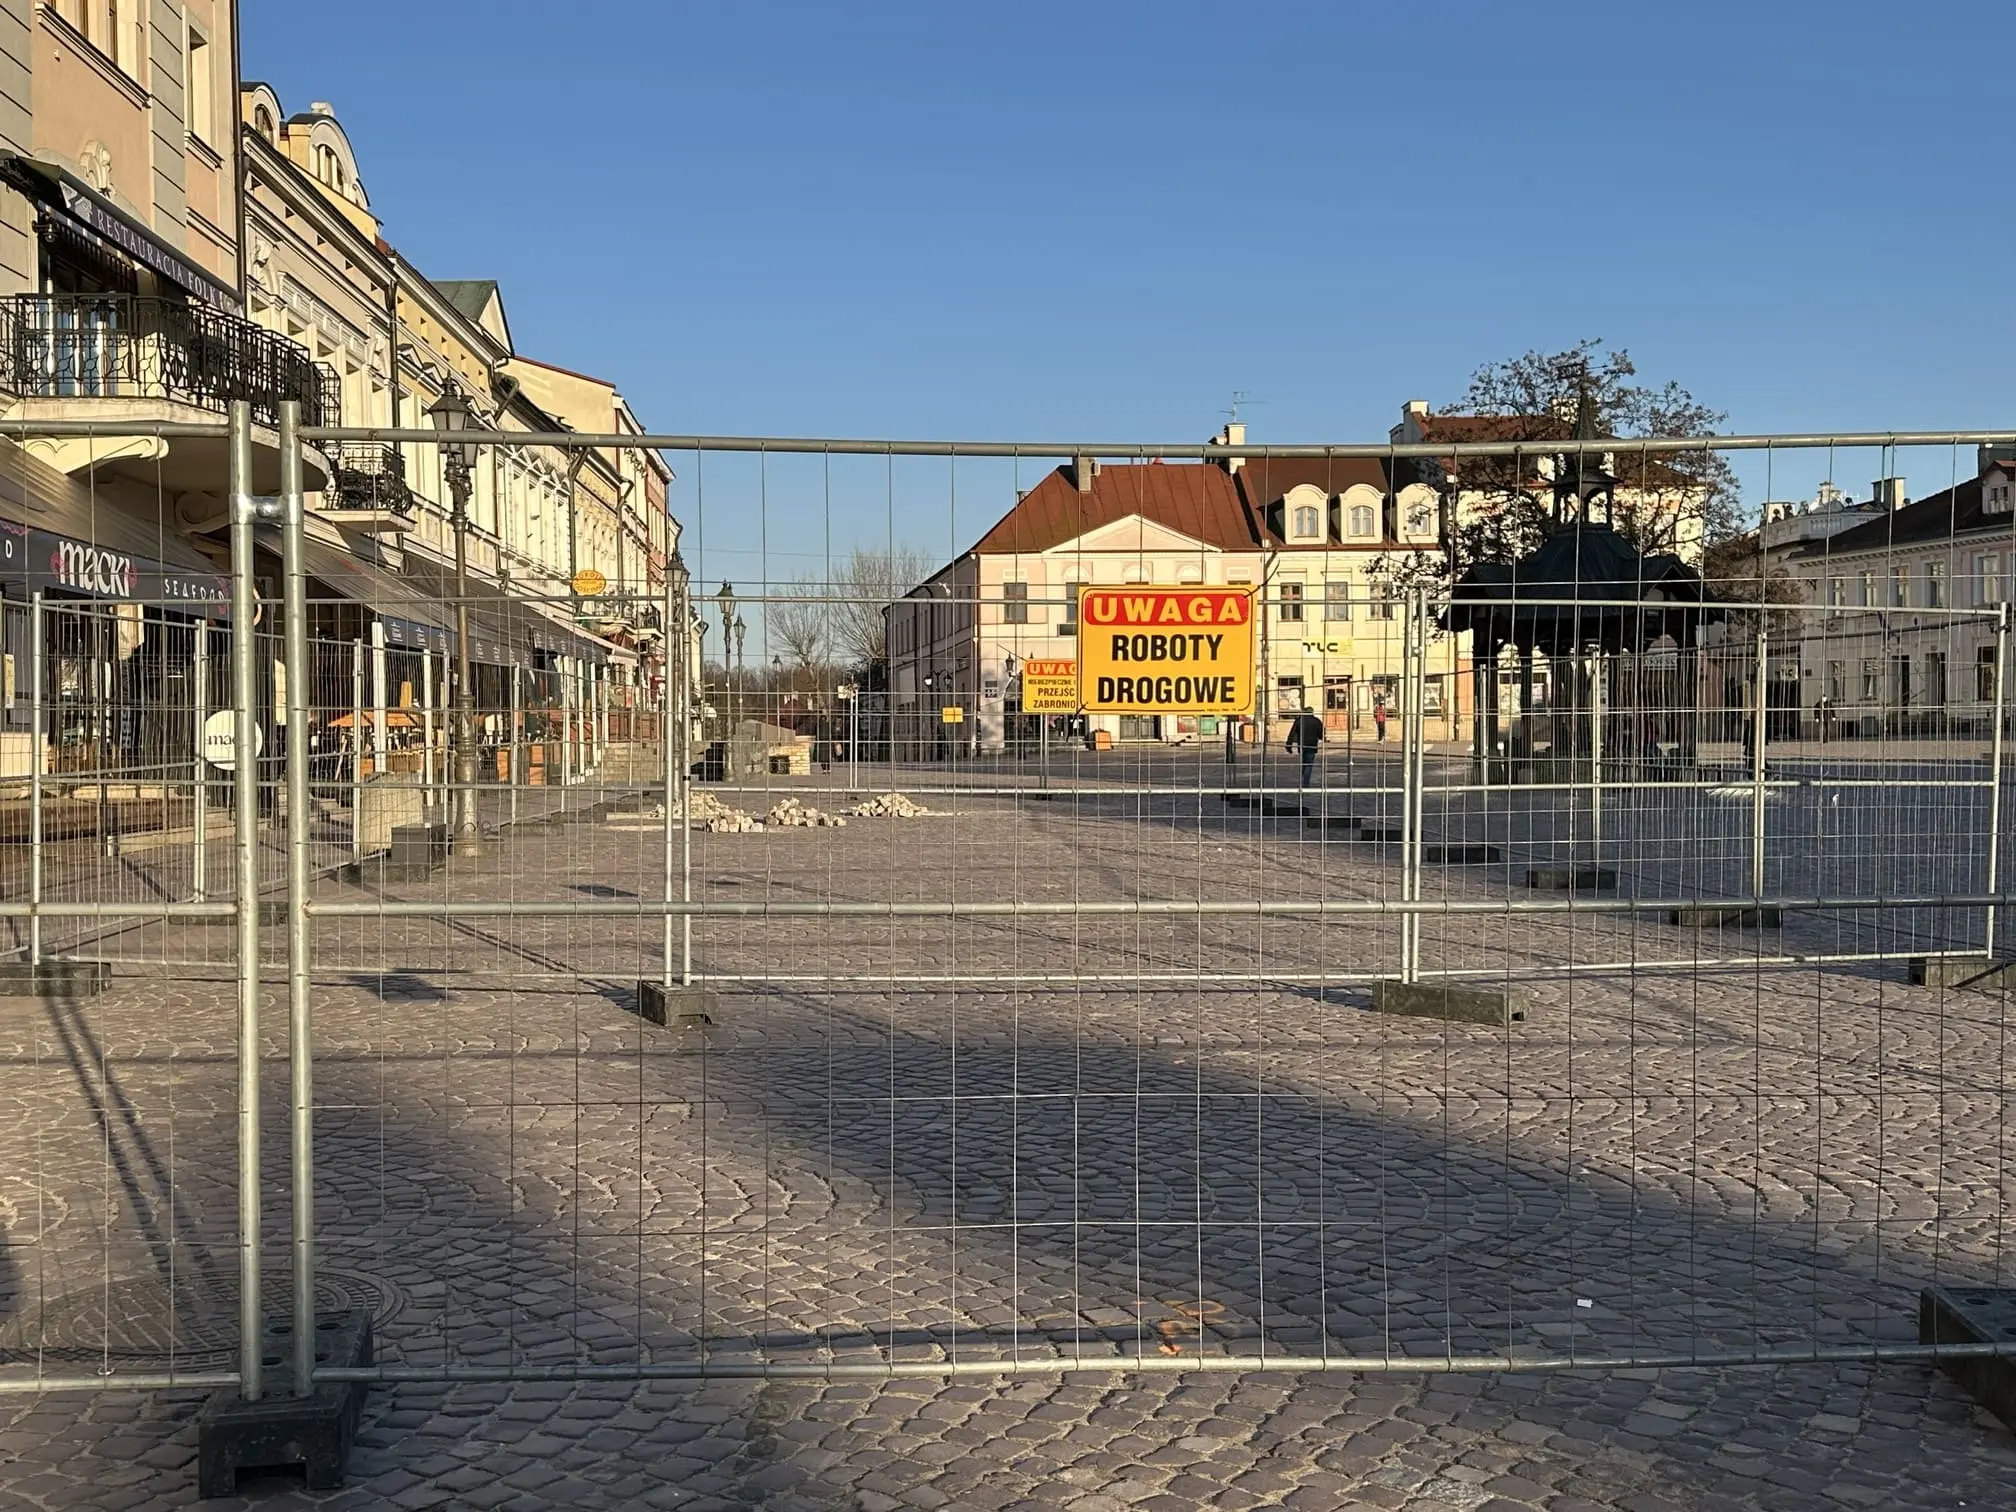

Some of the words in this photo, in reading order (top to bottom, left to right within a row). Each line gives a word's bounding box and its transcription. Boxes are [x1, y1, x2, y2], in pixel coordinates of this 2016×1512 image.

[187, 271, 217, 306] FOLK
[1093, 596, 1242, 623] UWAGA
[1112, 634, 1223, 661] ROBOTY
[1097, 676, 1235, 704] DROGOWE
